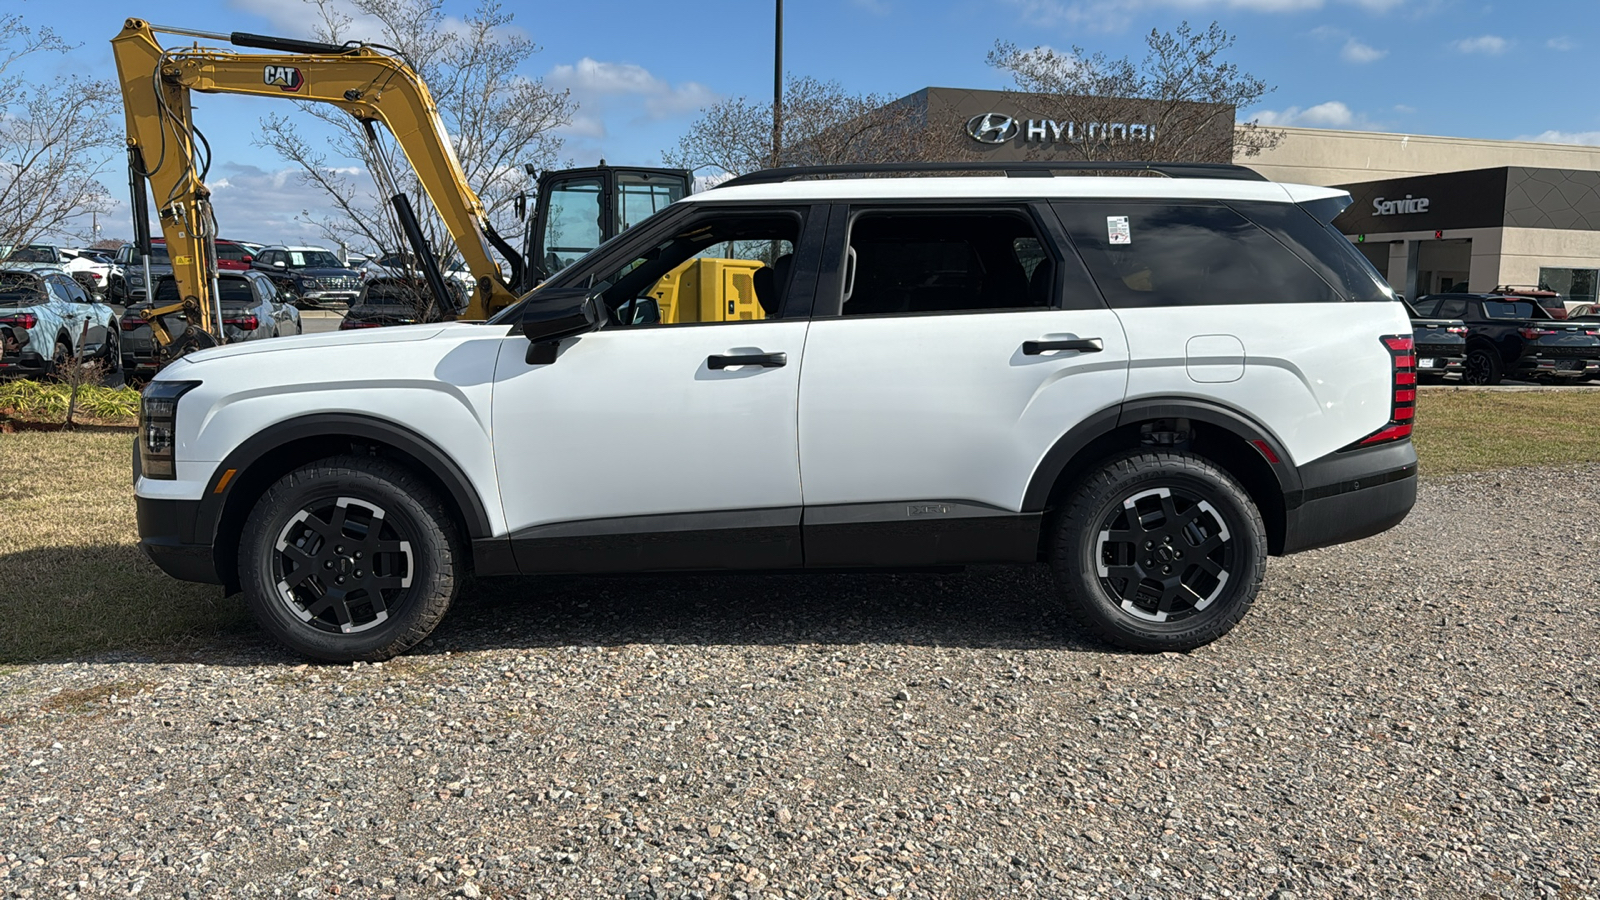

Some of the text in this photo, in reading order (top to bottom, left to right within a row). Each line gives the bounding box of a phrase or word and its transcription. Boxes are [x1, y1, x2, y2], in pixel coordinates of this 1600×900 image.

[264, 65, 295, 86] CAT
[1028, 119, 1156, 142] HYUNDAI
[1372, 194, 1429, 216] Service
